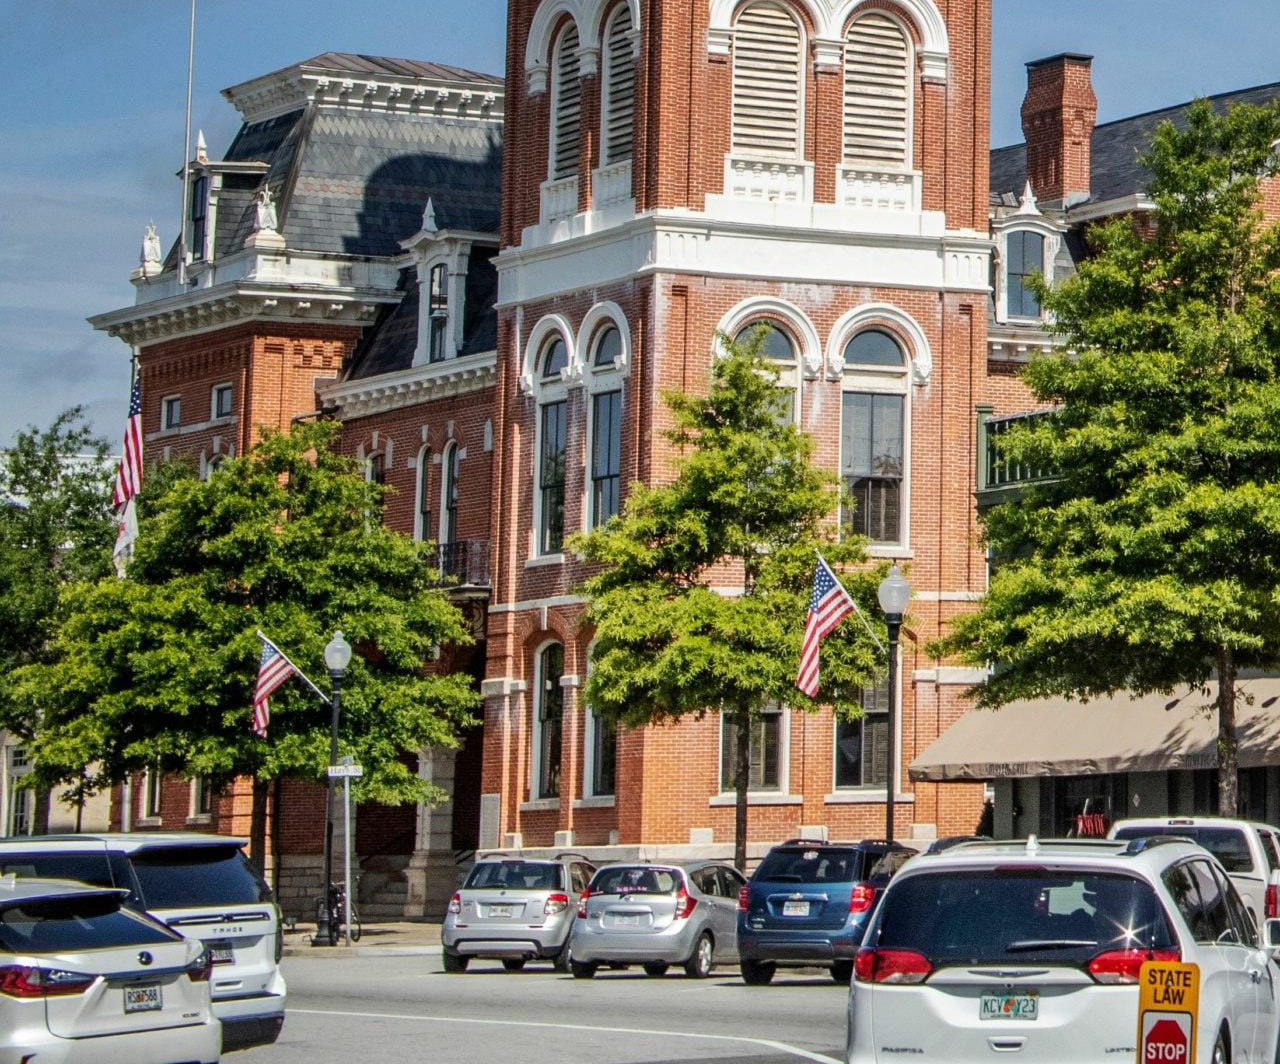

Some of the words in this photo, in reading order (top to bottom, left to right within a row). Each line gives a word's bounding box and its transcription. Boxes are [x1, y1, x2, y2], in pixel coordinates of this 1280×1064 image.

[212, 926, 244, 934] TAHOE
[1148, 968, 1192, 987] STATE
[1153, 986, 1185, 1005] LAW
[1147, 1042, 1185, 1060] STOP
